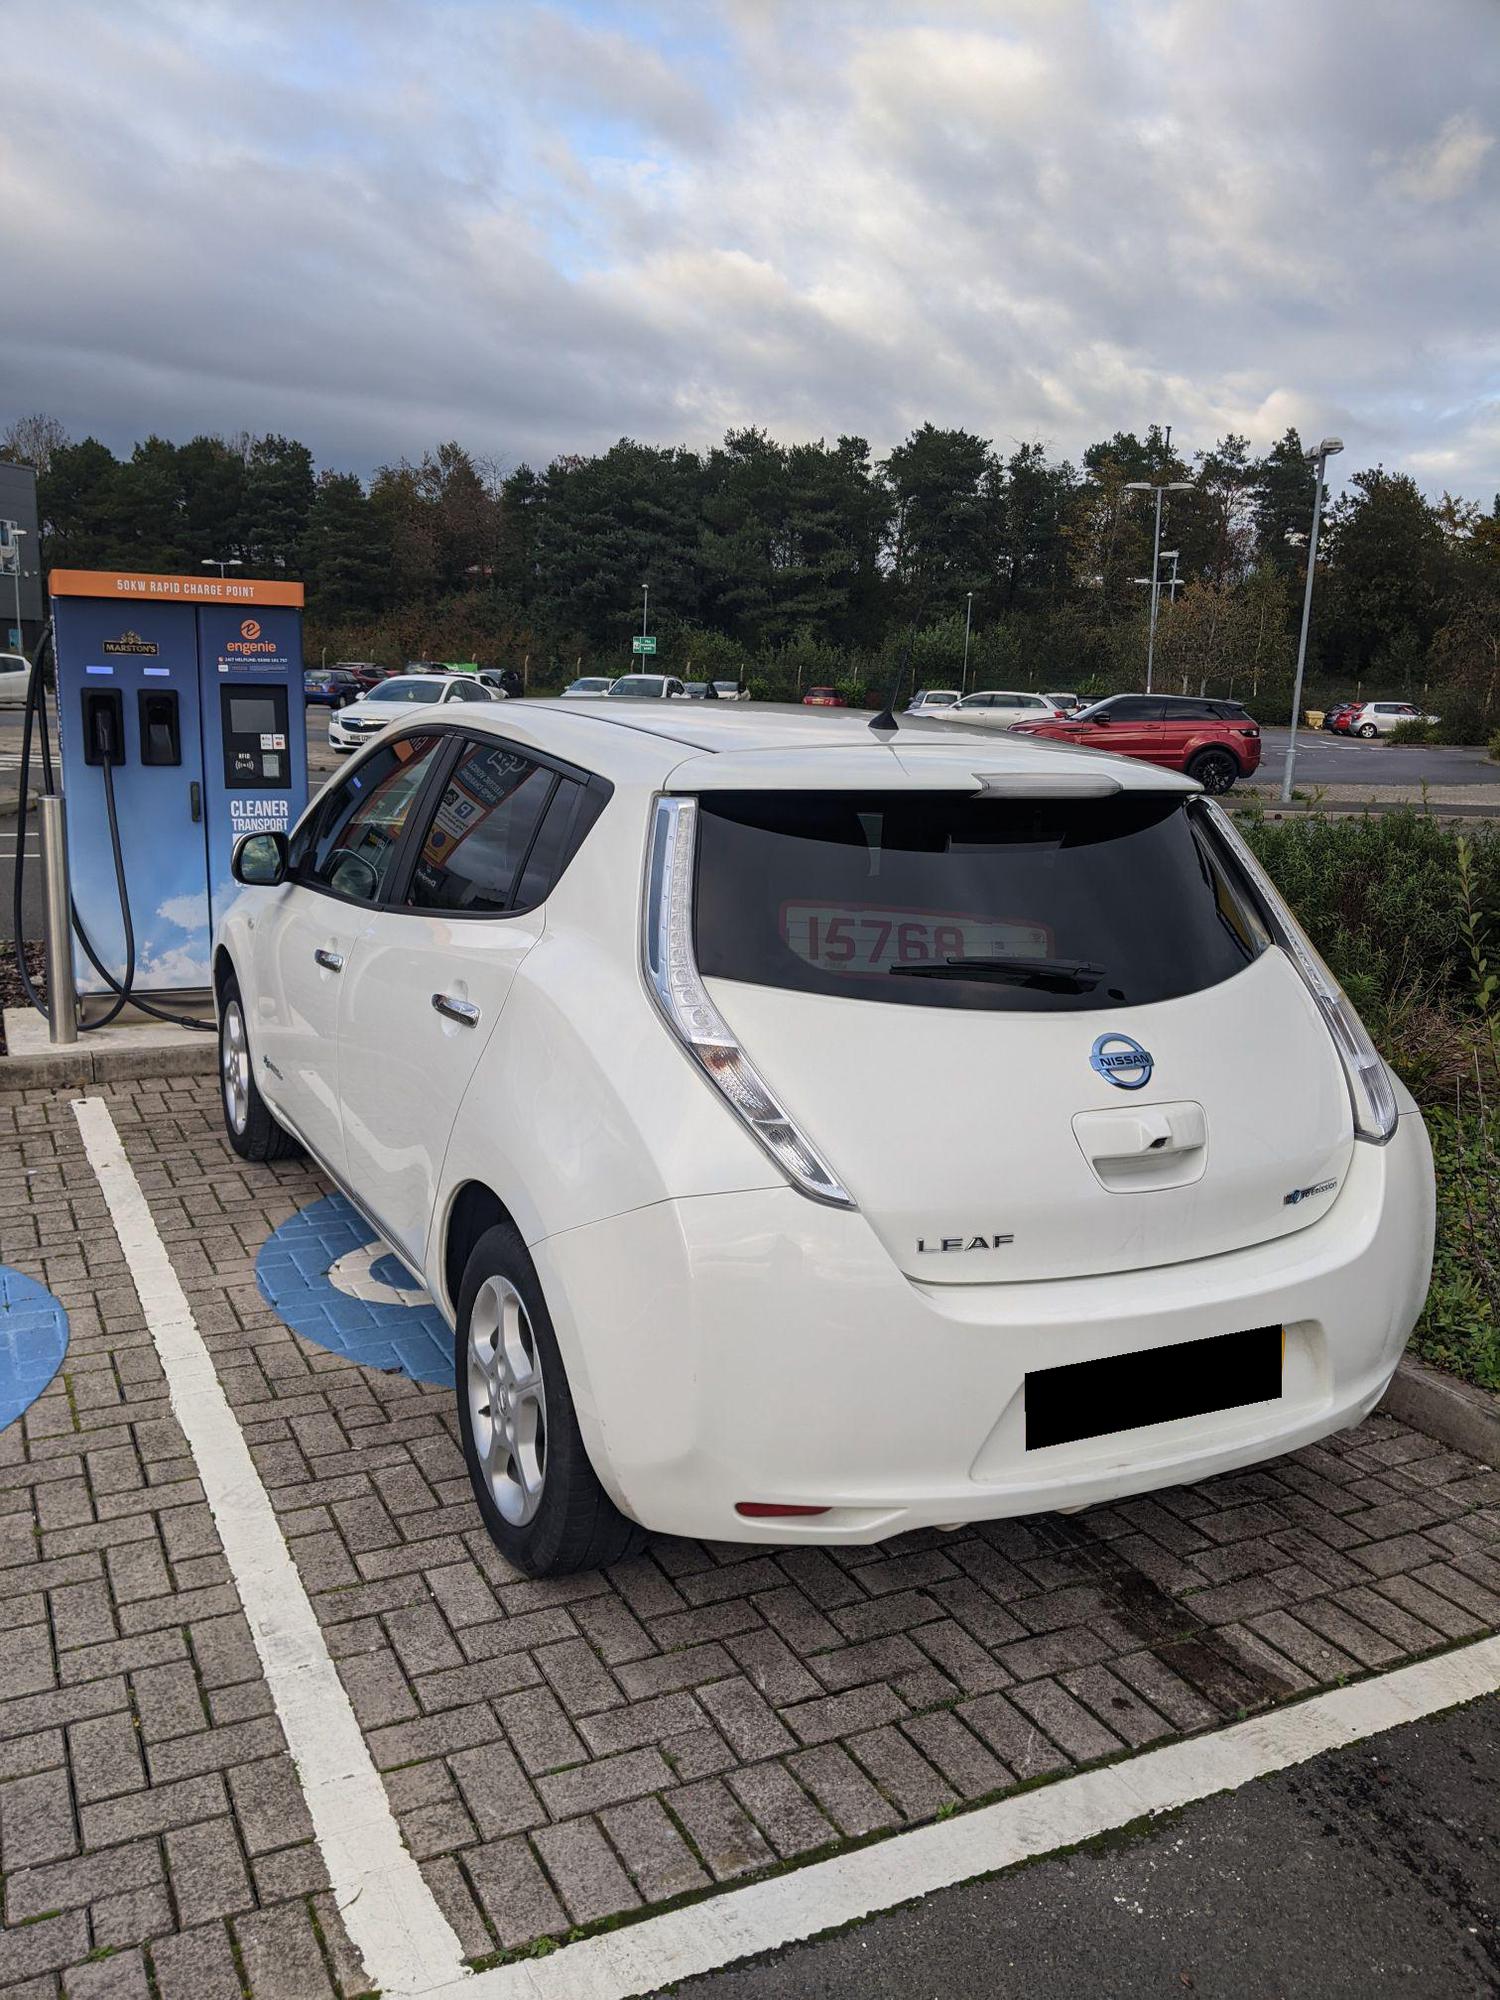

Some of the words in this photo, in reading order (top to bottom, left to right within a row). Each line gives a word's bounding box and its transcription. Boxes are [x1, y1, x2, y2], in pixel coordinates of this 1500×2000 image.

[117, 579, 146, 591] 50KW
[150, 581, 180, 594] RAPID
[183, 583, 222, 596] CHARGE
[226, 585, 255, 597] POINT
[105, 643, 156, 653] MARSTON'S
[226, 640, 277, 655] engenie
[230, 800, 288, 816] CLEANER
[232, 818, 288, 831] TRANSPORT
[808, 916, 965, 963] 15768
[1100, 1054, 1149, 1067] NISSAN
[916, 1234, 1015, 1253] LEAF
